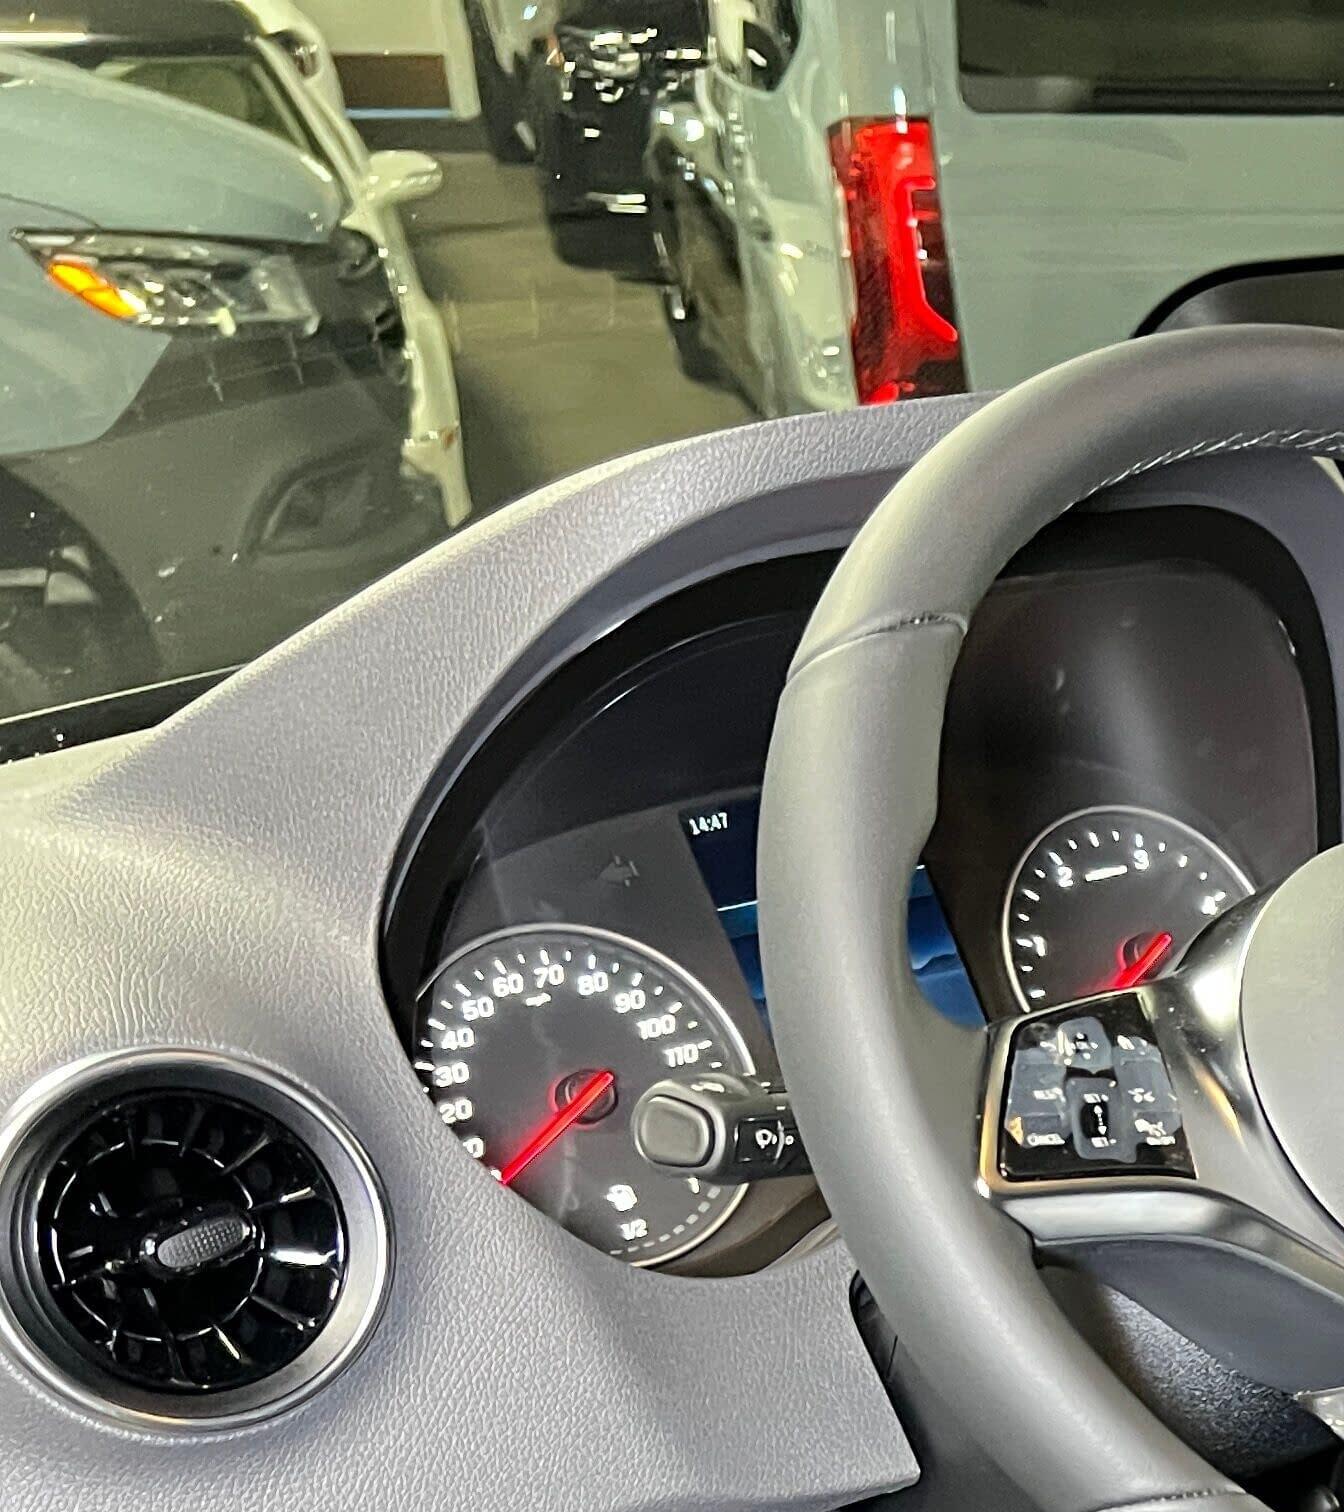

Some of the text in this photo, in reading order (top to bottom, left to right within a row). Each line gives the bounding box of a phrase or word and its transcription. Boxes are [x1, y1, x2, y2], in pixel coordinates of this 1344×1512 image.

[1134, 849, 1149, 870] 3
[1057, 866, 1073, 888] 2
[492, 973, 524, 998] 60
[533, 964, 564, 989] 70
[577, 971, 609, 996] 80
[462, 996, 495, 1021] 50
[613, 989, 646, 1014] 90
[441, 1027, 475, 1050] 40
[636, 1014, 676, 1041] 100
[664, 1043, 699, 1068] 110
[433, 1061, 470, 1088] 30
[439, 1099, 473, 1124] 20
